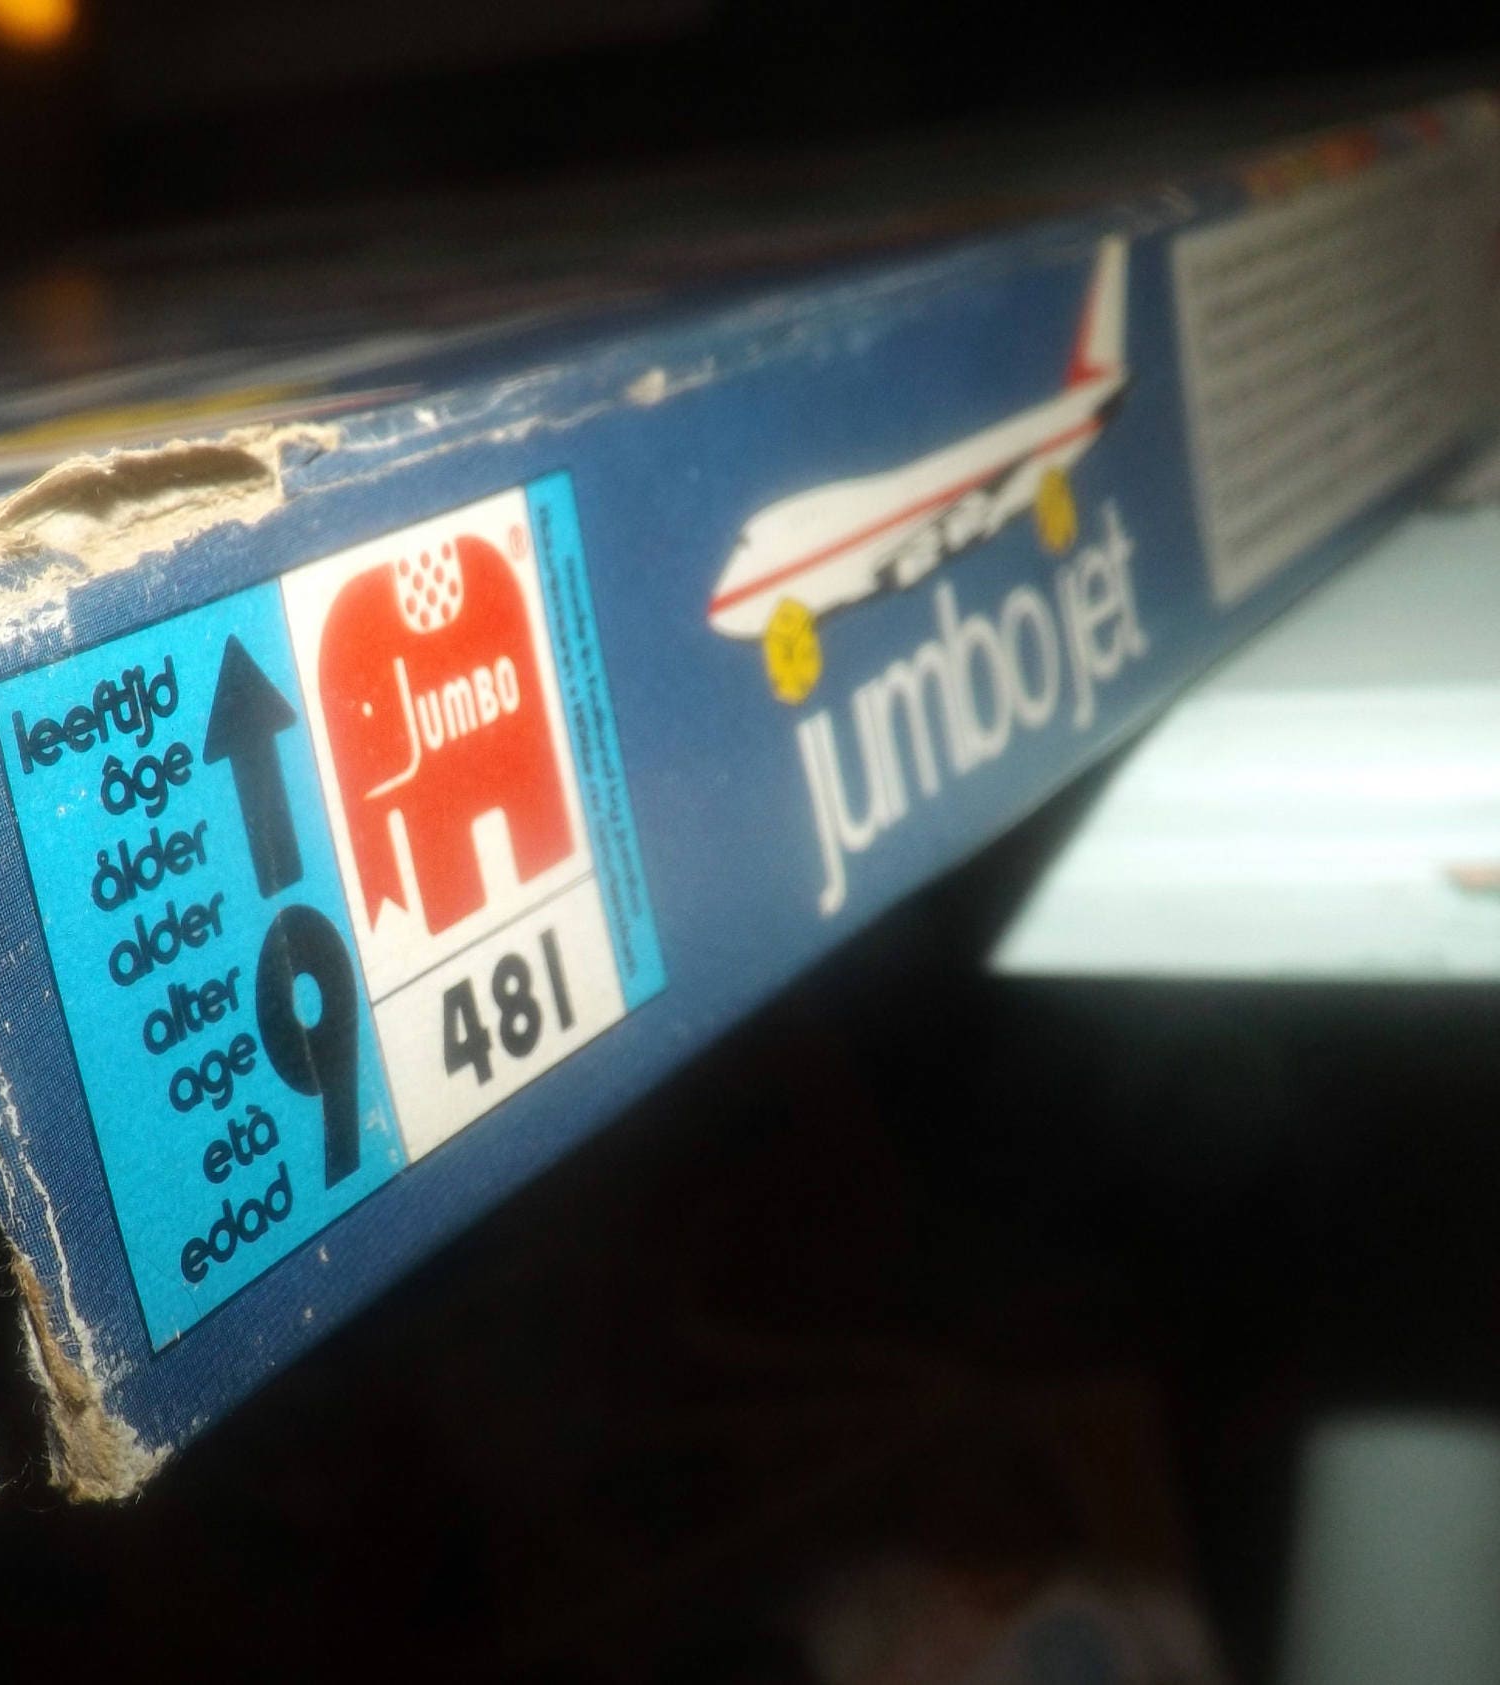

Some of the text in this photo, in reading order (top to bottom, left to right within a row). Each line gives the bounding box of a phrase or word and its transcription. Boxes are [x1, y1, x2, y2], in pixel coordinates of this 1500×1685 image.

[11, 654, 179, 775] leeftijd
[795, 578, 1060, 917] jumbo
[1055, 498, 1149, 731] jet
[100, 741, 194, 819] âge
[91, 819, 208, 911] ålder
[108, 892, 225, 987] alder
[143, 966, 241, 1056] alter
[255, 904, 360, 1190] 9
[441, 927, 578, 1088] 481
[169, 1032, 257, 1113] age
[203, 1104, 280, 1184] età
[181, 1160, 293, 1284] edad
